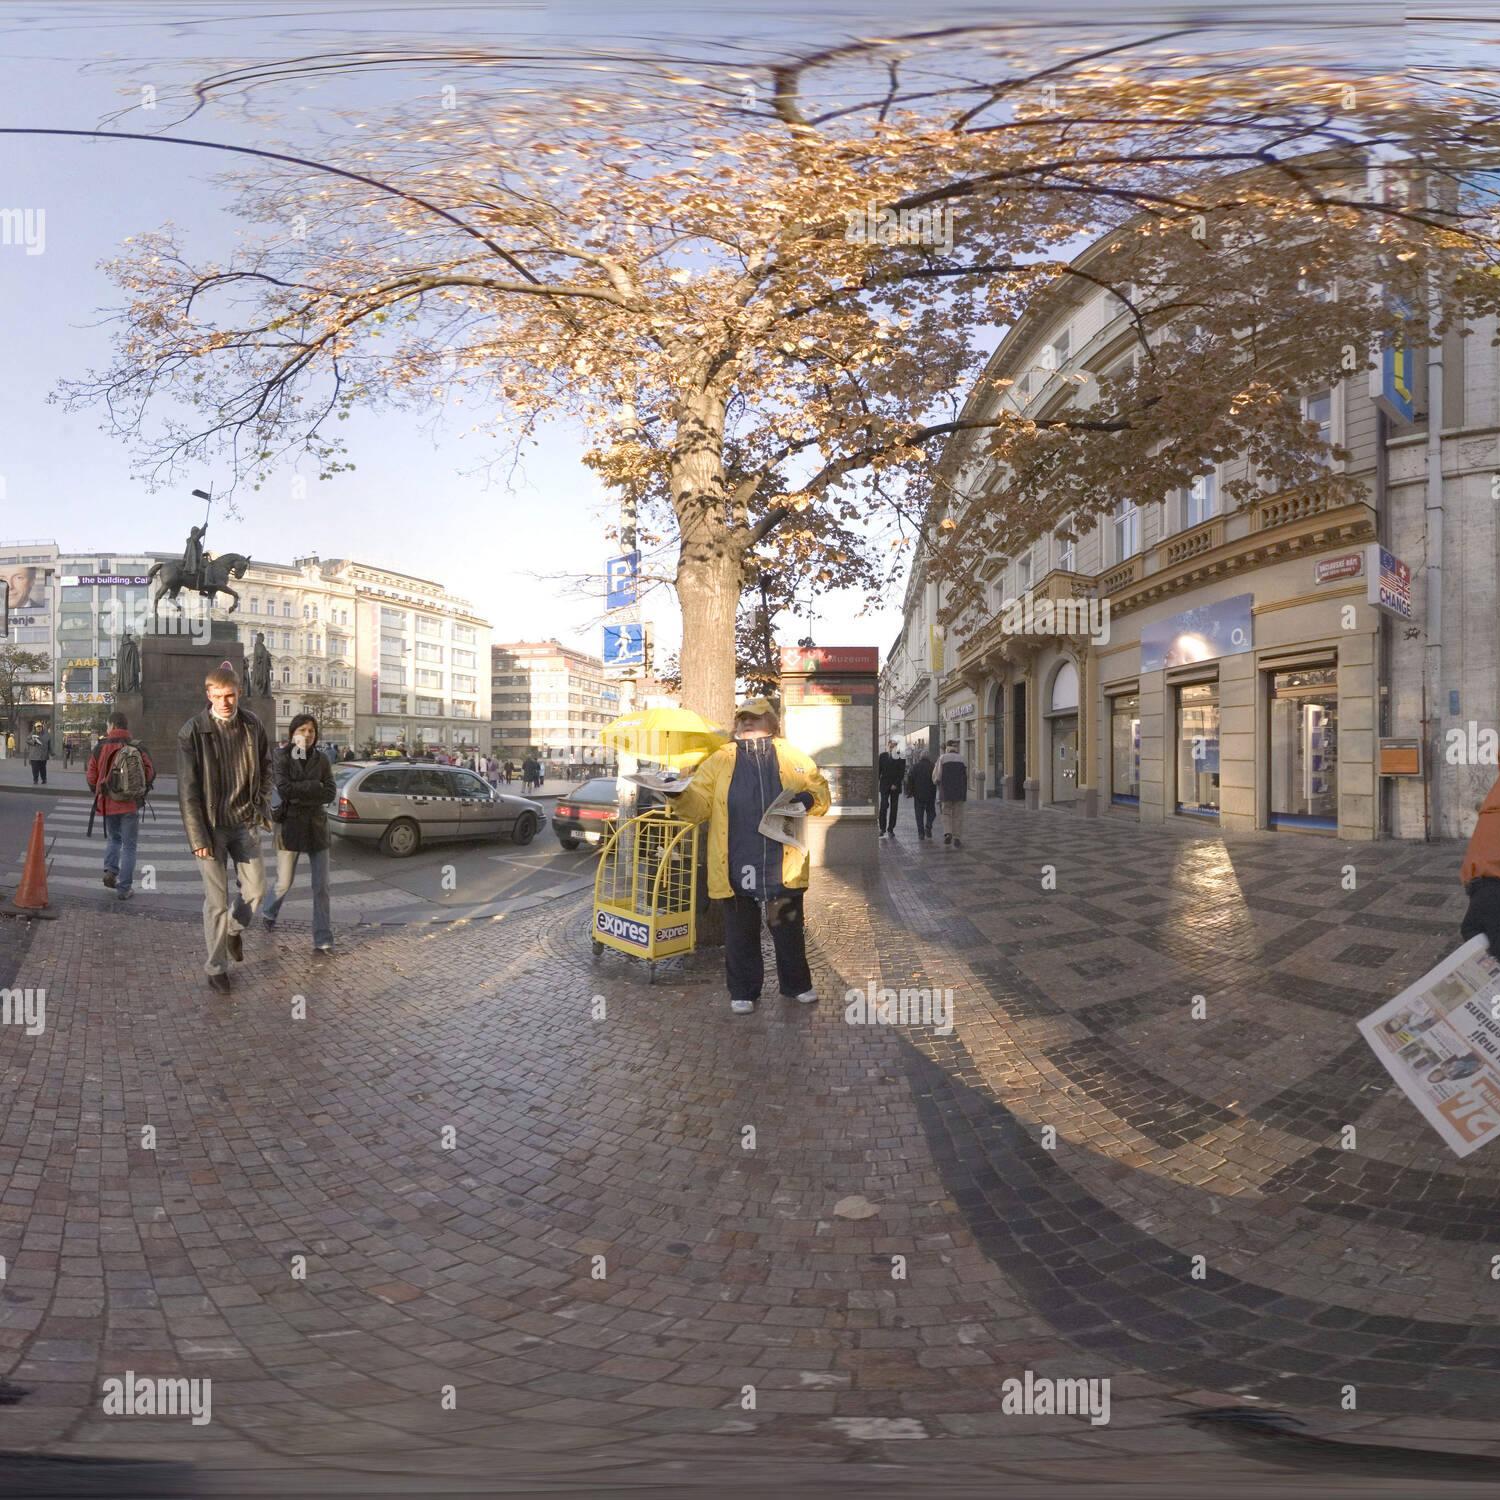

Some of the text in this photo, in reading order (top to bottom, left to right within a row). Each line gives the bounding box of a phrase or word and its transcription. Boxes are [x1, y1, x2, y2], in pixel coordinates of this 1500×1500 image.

[82, 576, 94, 584] the
[97, 576, 132, 585] building.
[611, 561, 632, 592] P
[1380, 587, 1411, 617] CHANGE
[829, 655, 870, 664] Muzeum
[597, 911, 648, 943] expres
[656, 925, 688, 942] expres
[1468, 1029, 1498, 1054] mají
